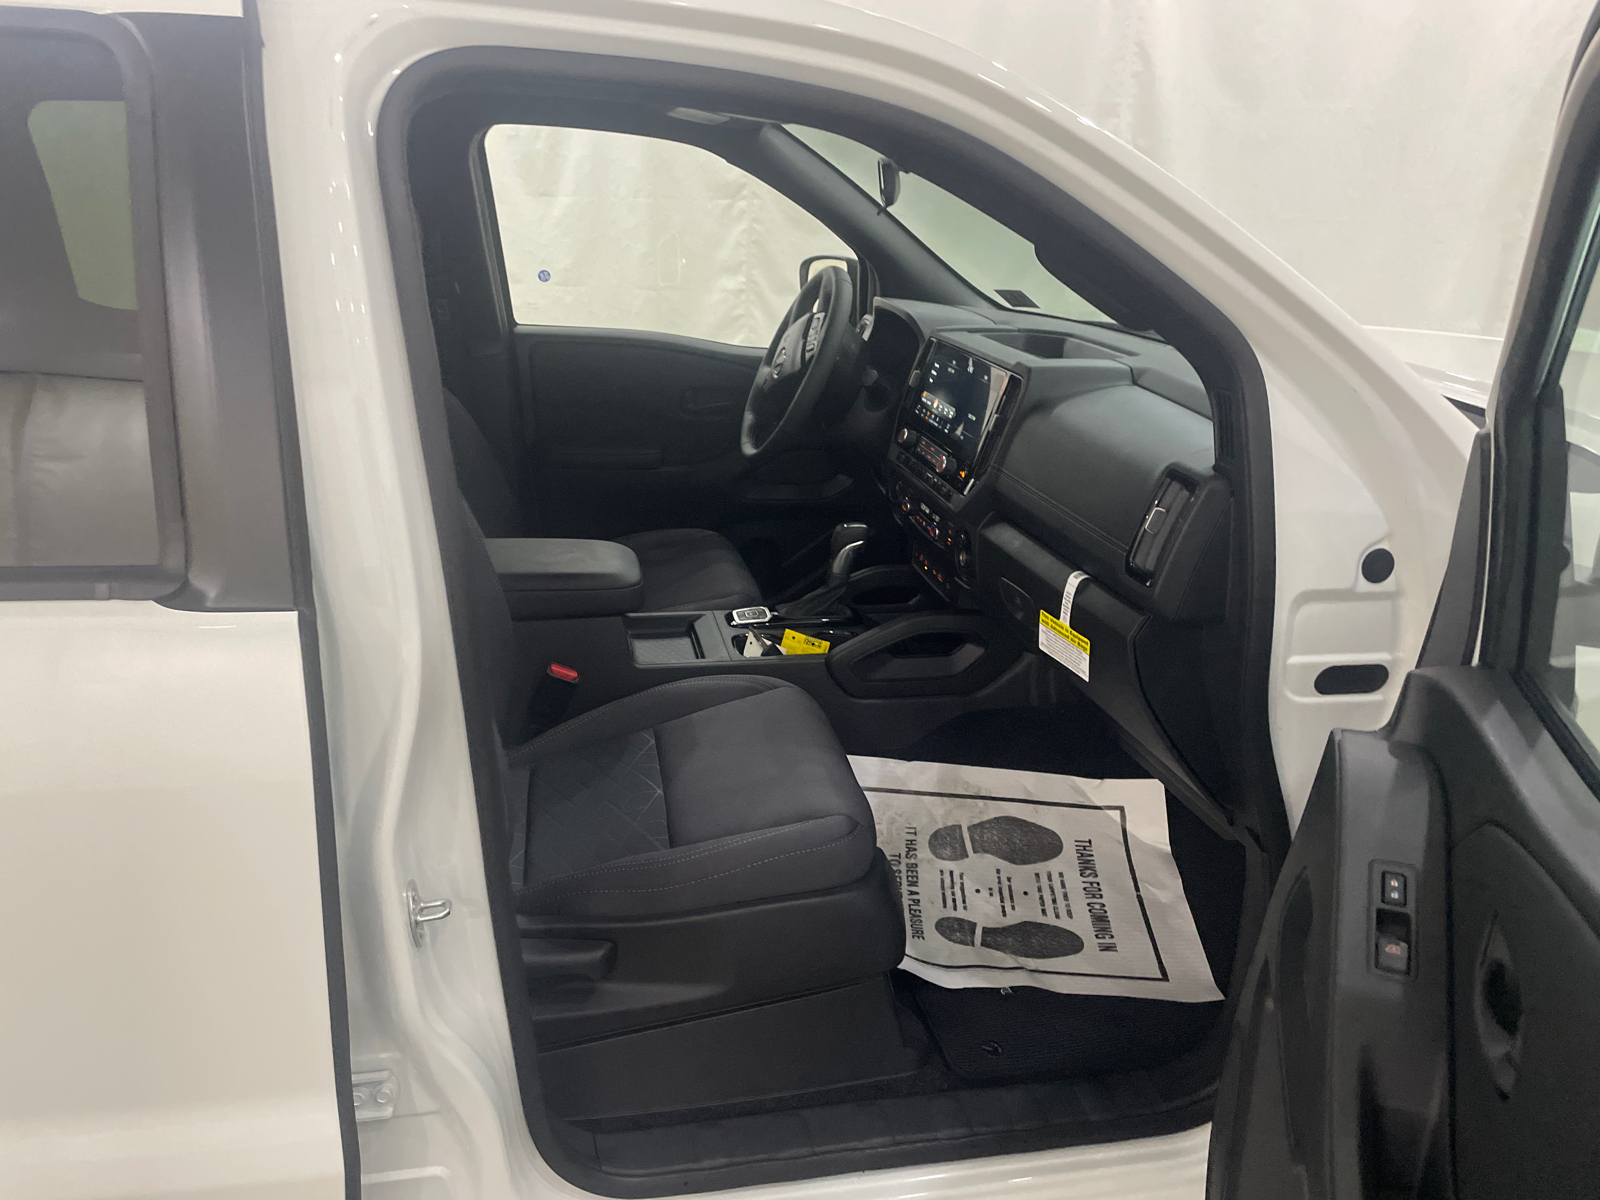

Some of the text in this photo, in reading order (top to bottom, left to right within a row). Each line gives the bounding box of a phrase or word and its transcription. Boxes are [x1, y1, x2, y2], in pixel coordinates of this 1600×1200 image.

[905, 827, 917, 836] IT
[889, 853, 901, 867] TO
[905, 839, 918, 860] HAS
[906, 863, 919, 887] BEEN
[1074, 839, 1118, 952] THANKS FOR COMING IN
[908, 898, 925, 940] PLEASURE
